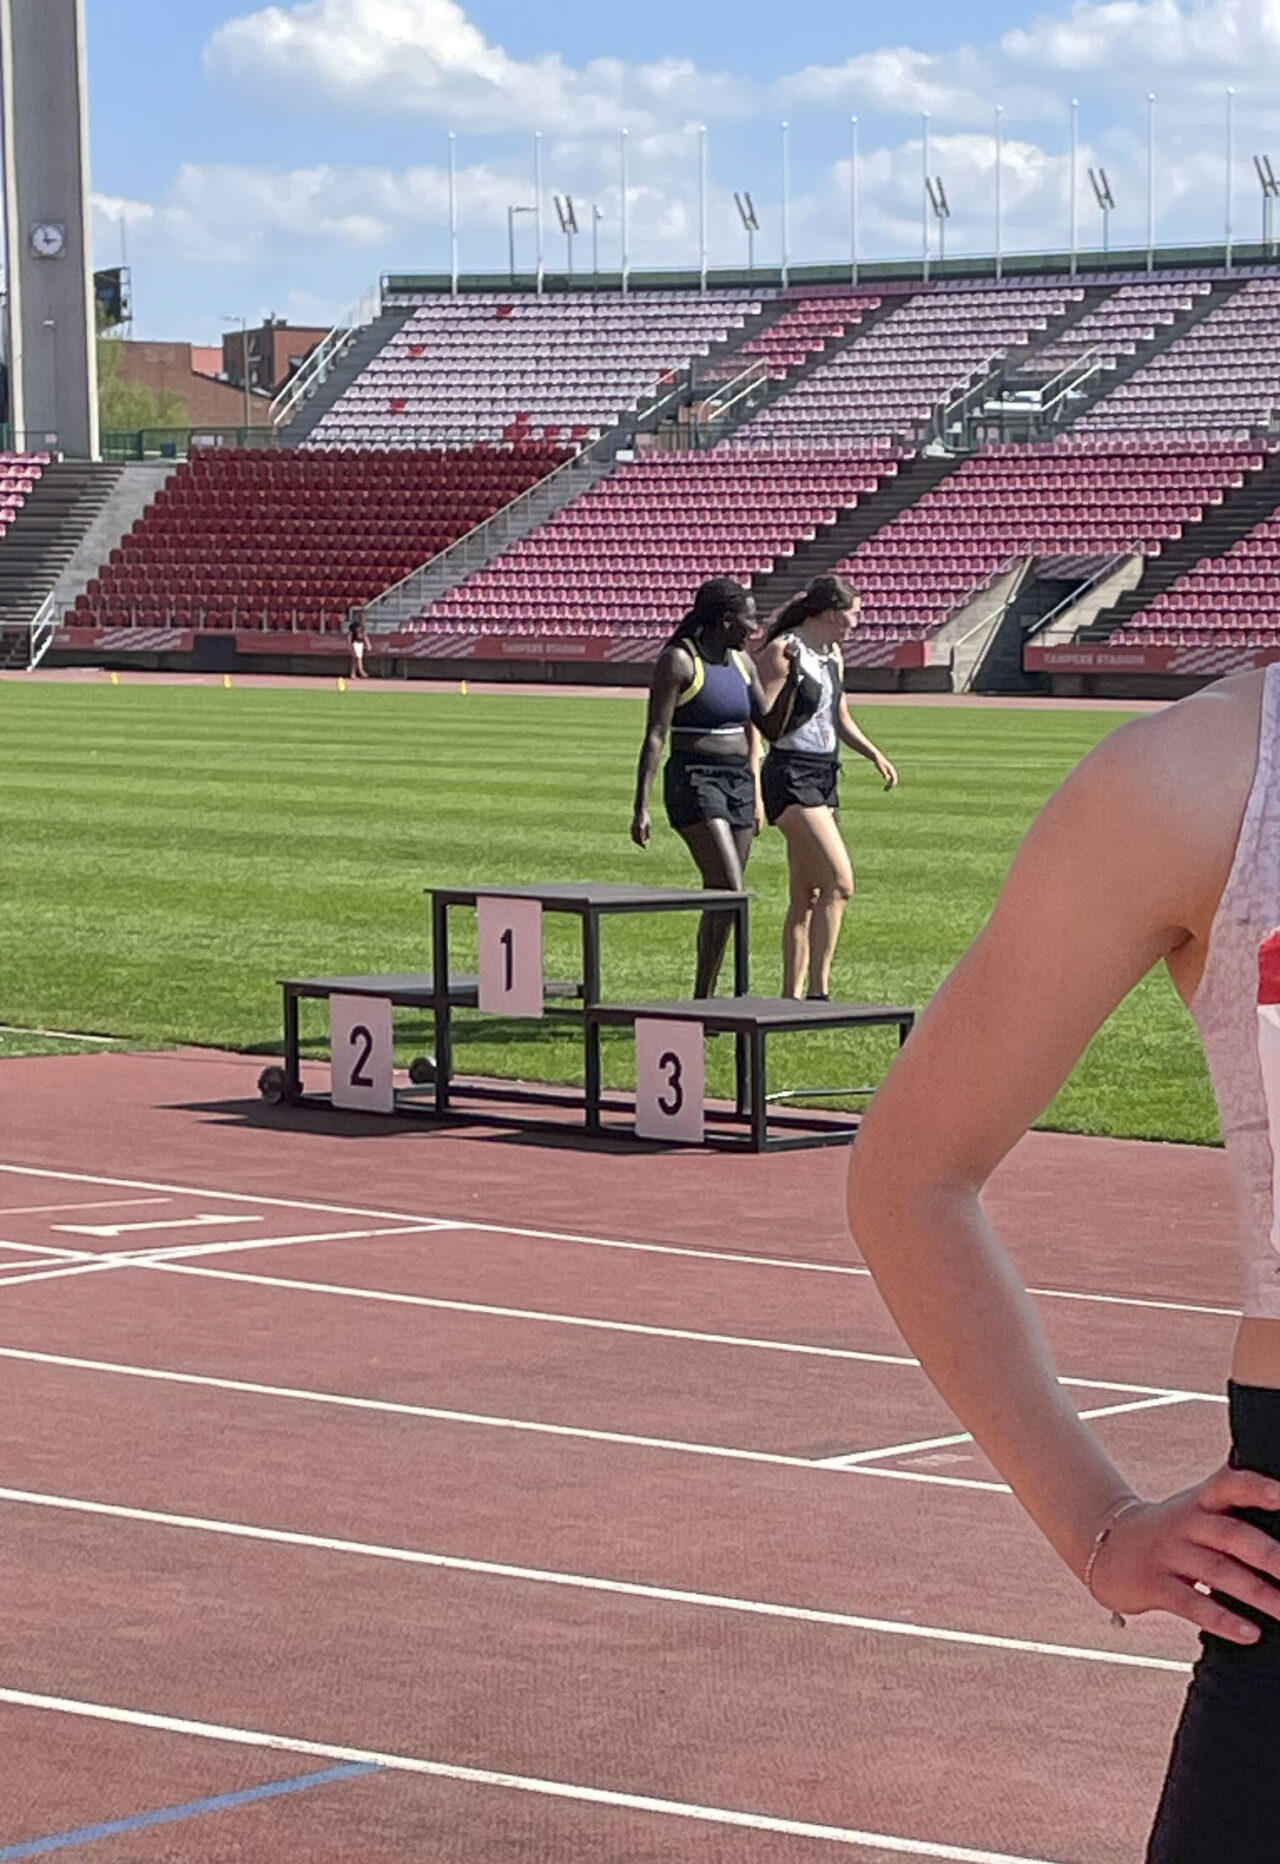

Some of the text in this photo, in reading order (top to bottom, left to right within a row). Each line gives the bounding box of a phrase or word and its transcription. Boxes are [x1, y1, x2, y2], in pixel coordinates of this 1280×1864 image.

[499, 928, 513, 991] 1
[349, 1026, 374, 1087] 2
[657, 1052, 683, 1116] 3
